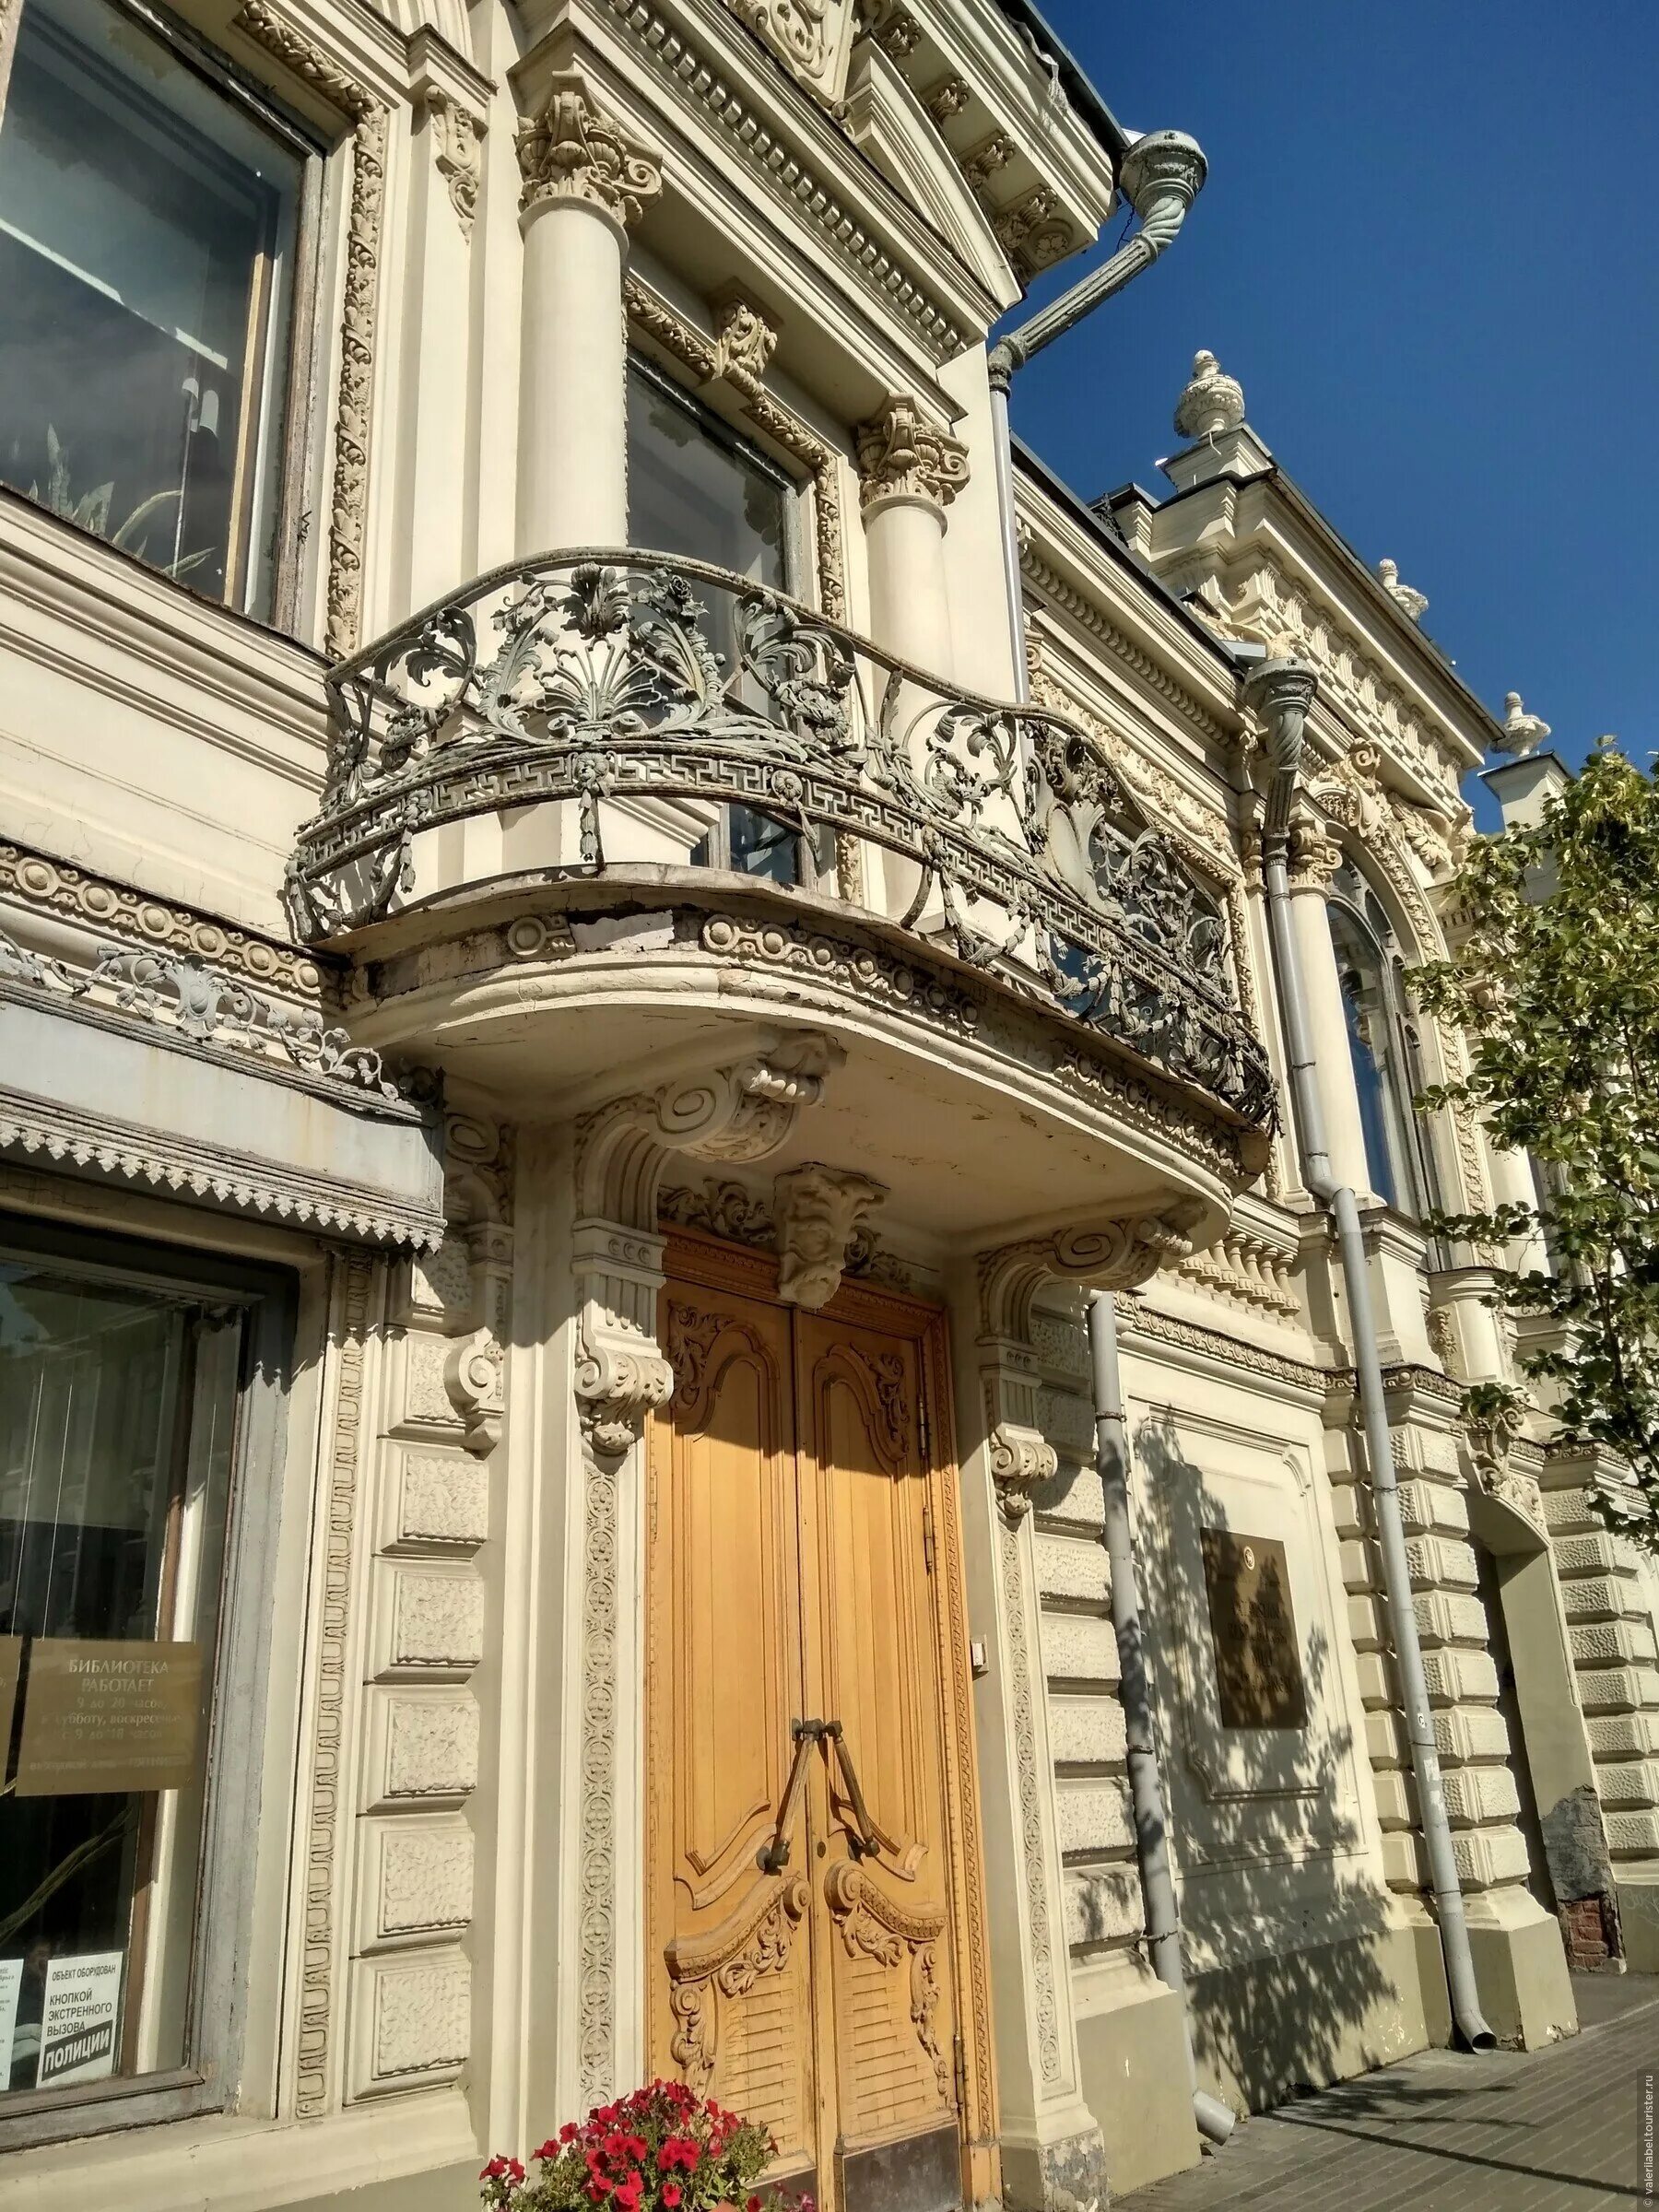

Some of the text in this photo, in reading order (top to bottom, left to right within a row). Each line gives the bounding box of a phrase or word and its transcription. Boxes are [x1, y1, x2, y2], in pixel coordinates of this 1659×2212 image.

[68, 1658, 170, 1675] БИБЛИОТЕКА
[81, 1677, 156, 1693] РАБОТАЕТ
[52, 1964, 116, 1983] ОБЪЕКТ ОБОРУДОВАН
[50, 1987, 93, 2006] КНОПКОЙ
[48, 2002, 112, 2022] ЭКСТРЕННОГО
[46, 2020, 87, 2037] ВЫЗОВА
[44, 2028, 111, 2074] ПОЛИЦИИ
